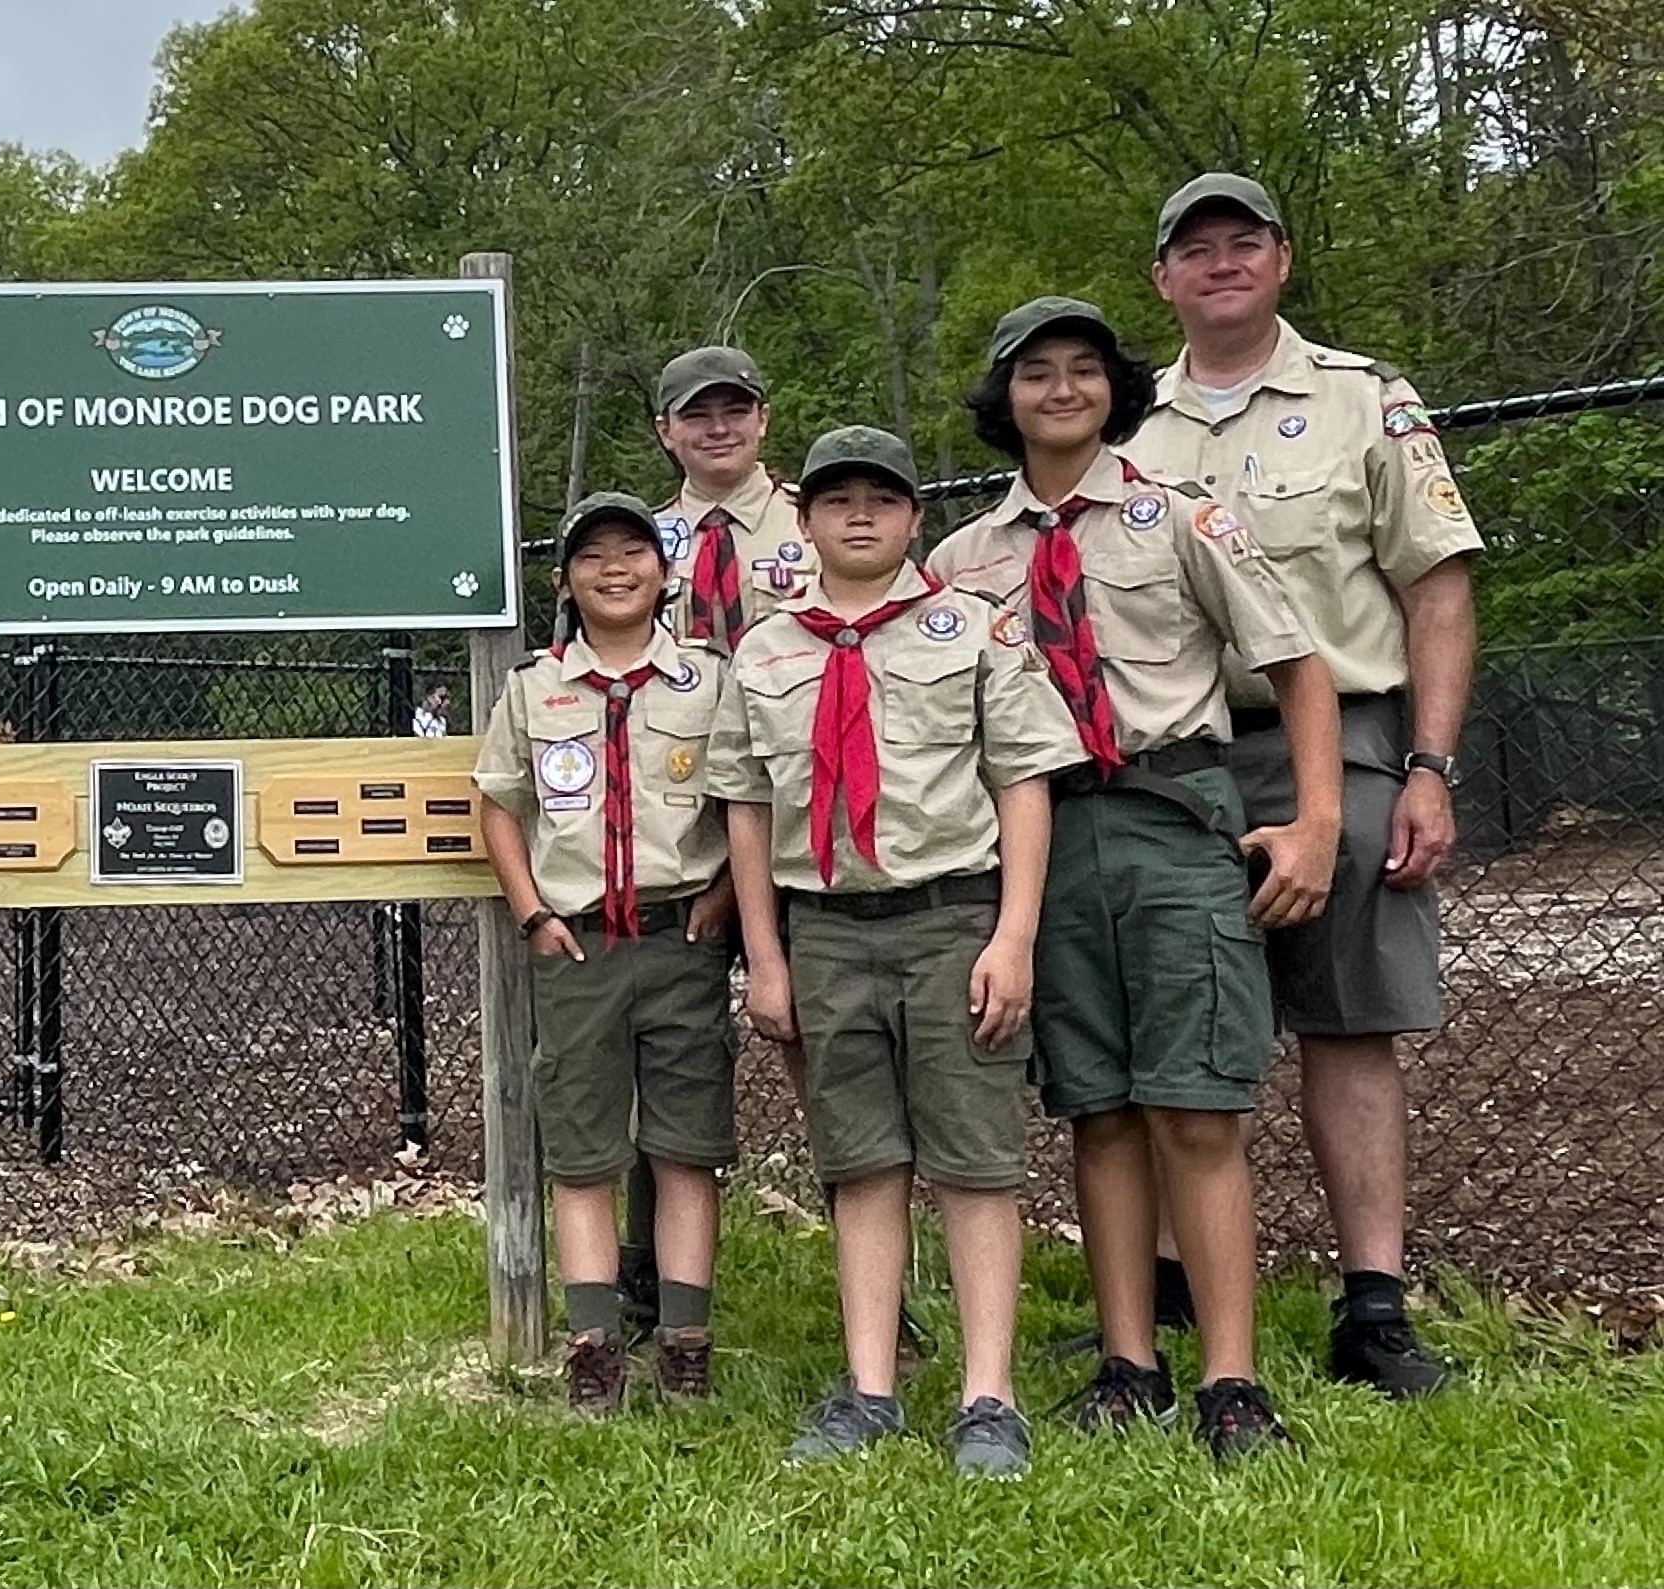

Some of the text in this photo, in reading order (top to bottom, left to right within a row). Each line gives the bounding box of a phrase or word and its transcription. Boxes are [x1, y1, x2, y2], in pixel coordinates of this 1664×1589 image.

[18, 397, 64, 427] OF
[74, 396, 233, 426] MONROE
[242, 395, 320, 425] DOG
[330, 394, 424, 424] PARK
[90, 467, 233, 493] WELCOME
[74, 508, 92, 522] to
[94, 505, 163, 522] off-leash
[165, 505, 228, 521] exercise
[229, 504, 298, 520] activities
[300, 503, 335, 519] with
[337, 505, 374, 522] your
[375, 503, 411, 522] dog.
[30, 524, 296, 545] Please observe the park guidelines.
[28, 578, 85, 601] Open
[89, 575, 143, 600] Daily
[161, 576, 175, 595] 9
[179, 575, 215, 594] AM
[221, 577, 244, 594] to
[249, 573, 300, 594] Dusk
